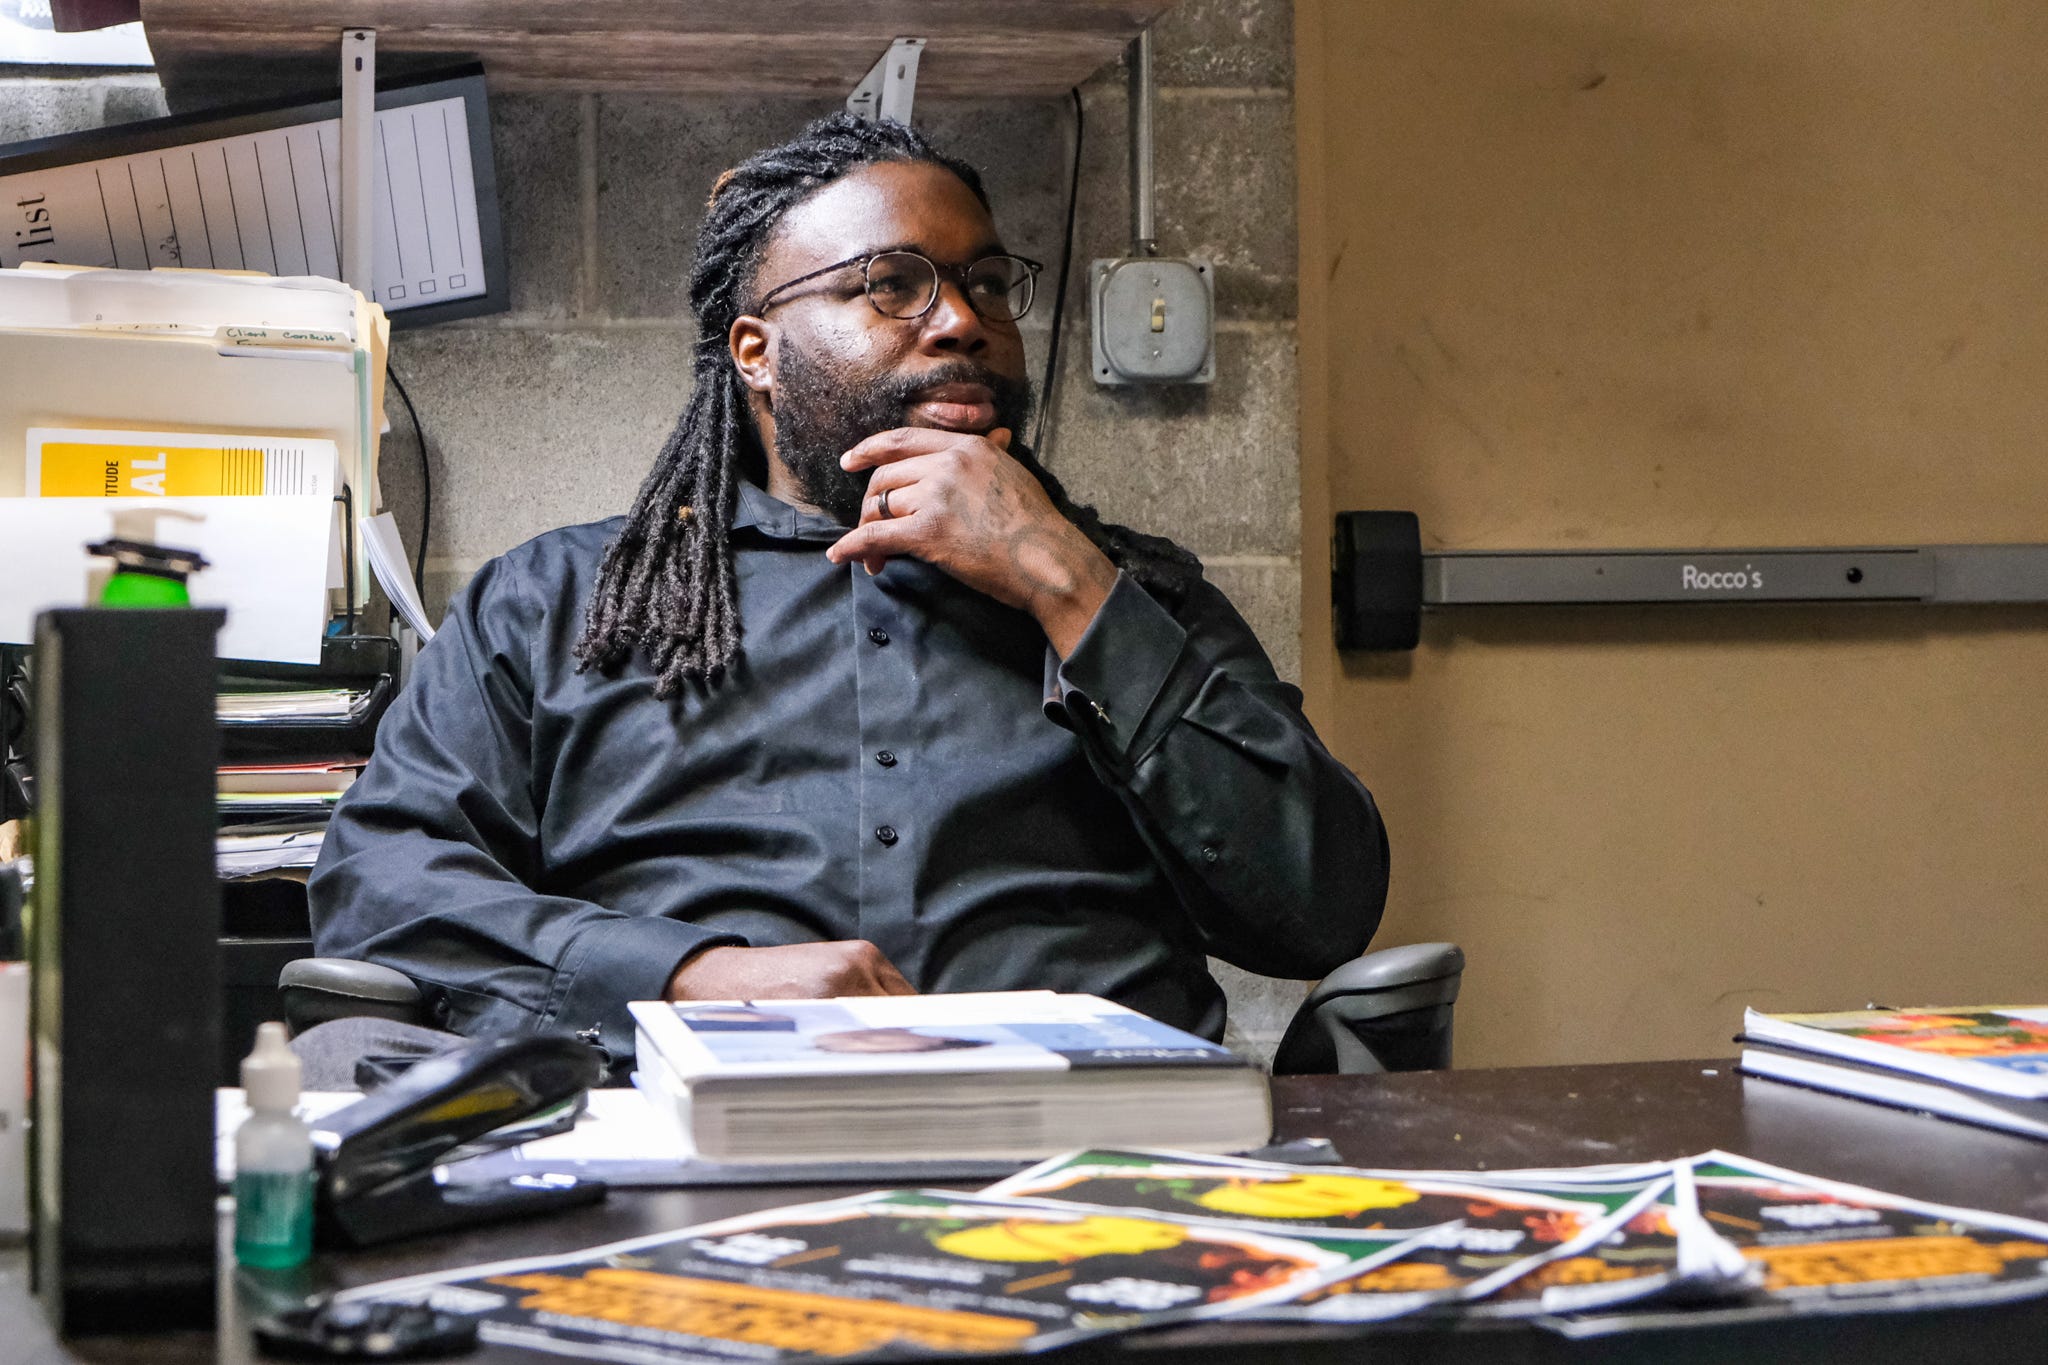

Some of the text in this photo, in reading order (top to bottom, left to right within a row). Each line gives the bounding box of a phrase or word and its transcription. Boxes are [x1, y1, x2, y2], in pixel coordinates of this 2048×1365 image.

[16, 192, 55, 250] list
[105, 460, 119, 496] ITUDE
[131, 452, 166, 496] AL
[1682, 564, 1763, 590] Rocco's
